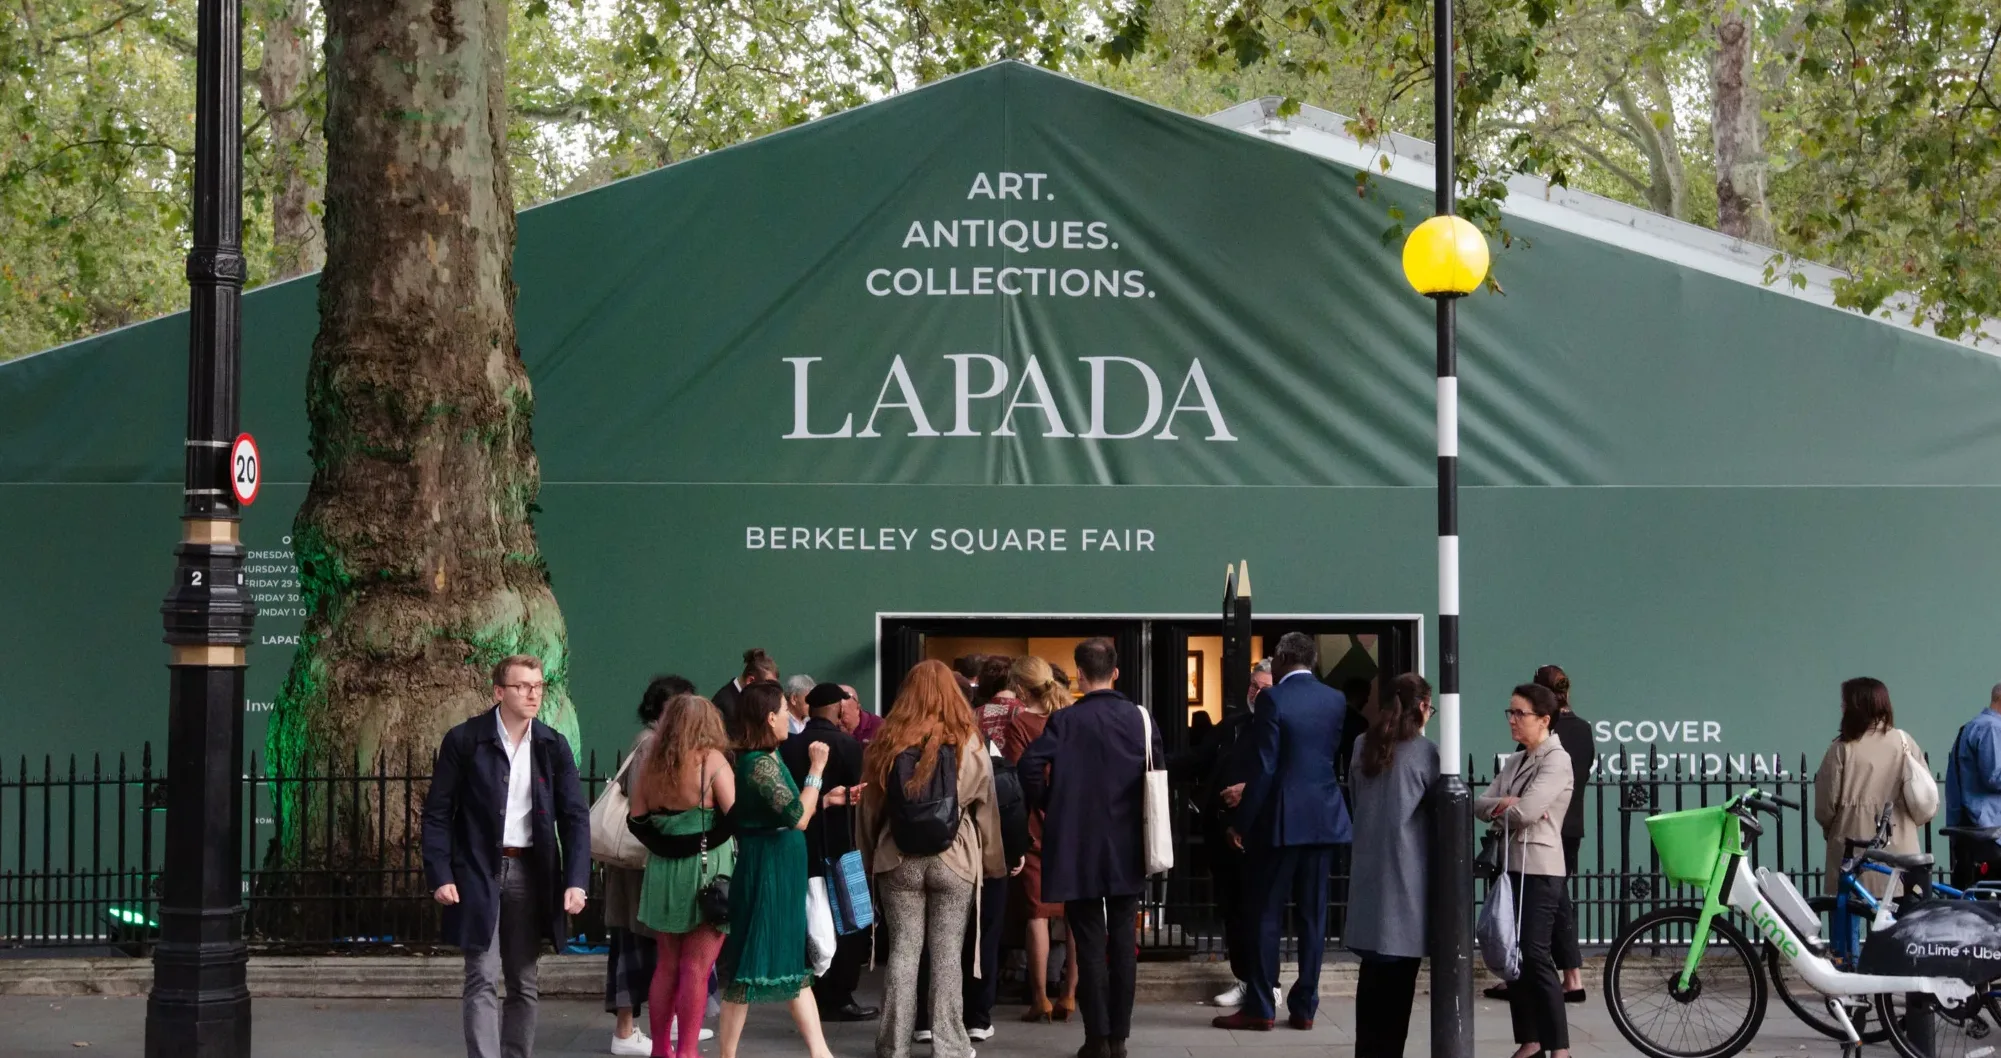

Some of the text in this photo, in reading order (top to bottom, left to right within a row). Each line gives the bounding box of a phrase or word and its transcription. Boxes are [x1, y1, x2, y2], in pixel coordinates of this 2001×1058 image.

[967, 172, 1055, 201] ART.
[902, 219, 1119, 253] ANTIQUES.
[866, 267, 1156, 299] COLLECTIONS.
[782, 353, 1239, 442] LAPADA
[236, 454, 256, 485] 20
[746, 526, 1155, 555] BERKELEY SQUARE FAIR
[247, 550, 295, 559] DNESDAY
[191, 571, 202, 586] 2
[242, 565, 288, 573] HURSDAY
[281, 579, 293, 588] 29
[287, 594, 299, 602] 30
[257, 608, 290, 617] UNDAY
[262, 635, 300, 645] LAPAD
[1594, 720, 1722, 743] SCOVER
[1589, 753, 1789, 776] XCEPTIONAL
[1751, 900, 1799, 961] Lime
[1906, 942, 1926, 955] On
[1928, 943, 1960, 957] Lime
[1973, 946, 2001, 960] Ube
